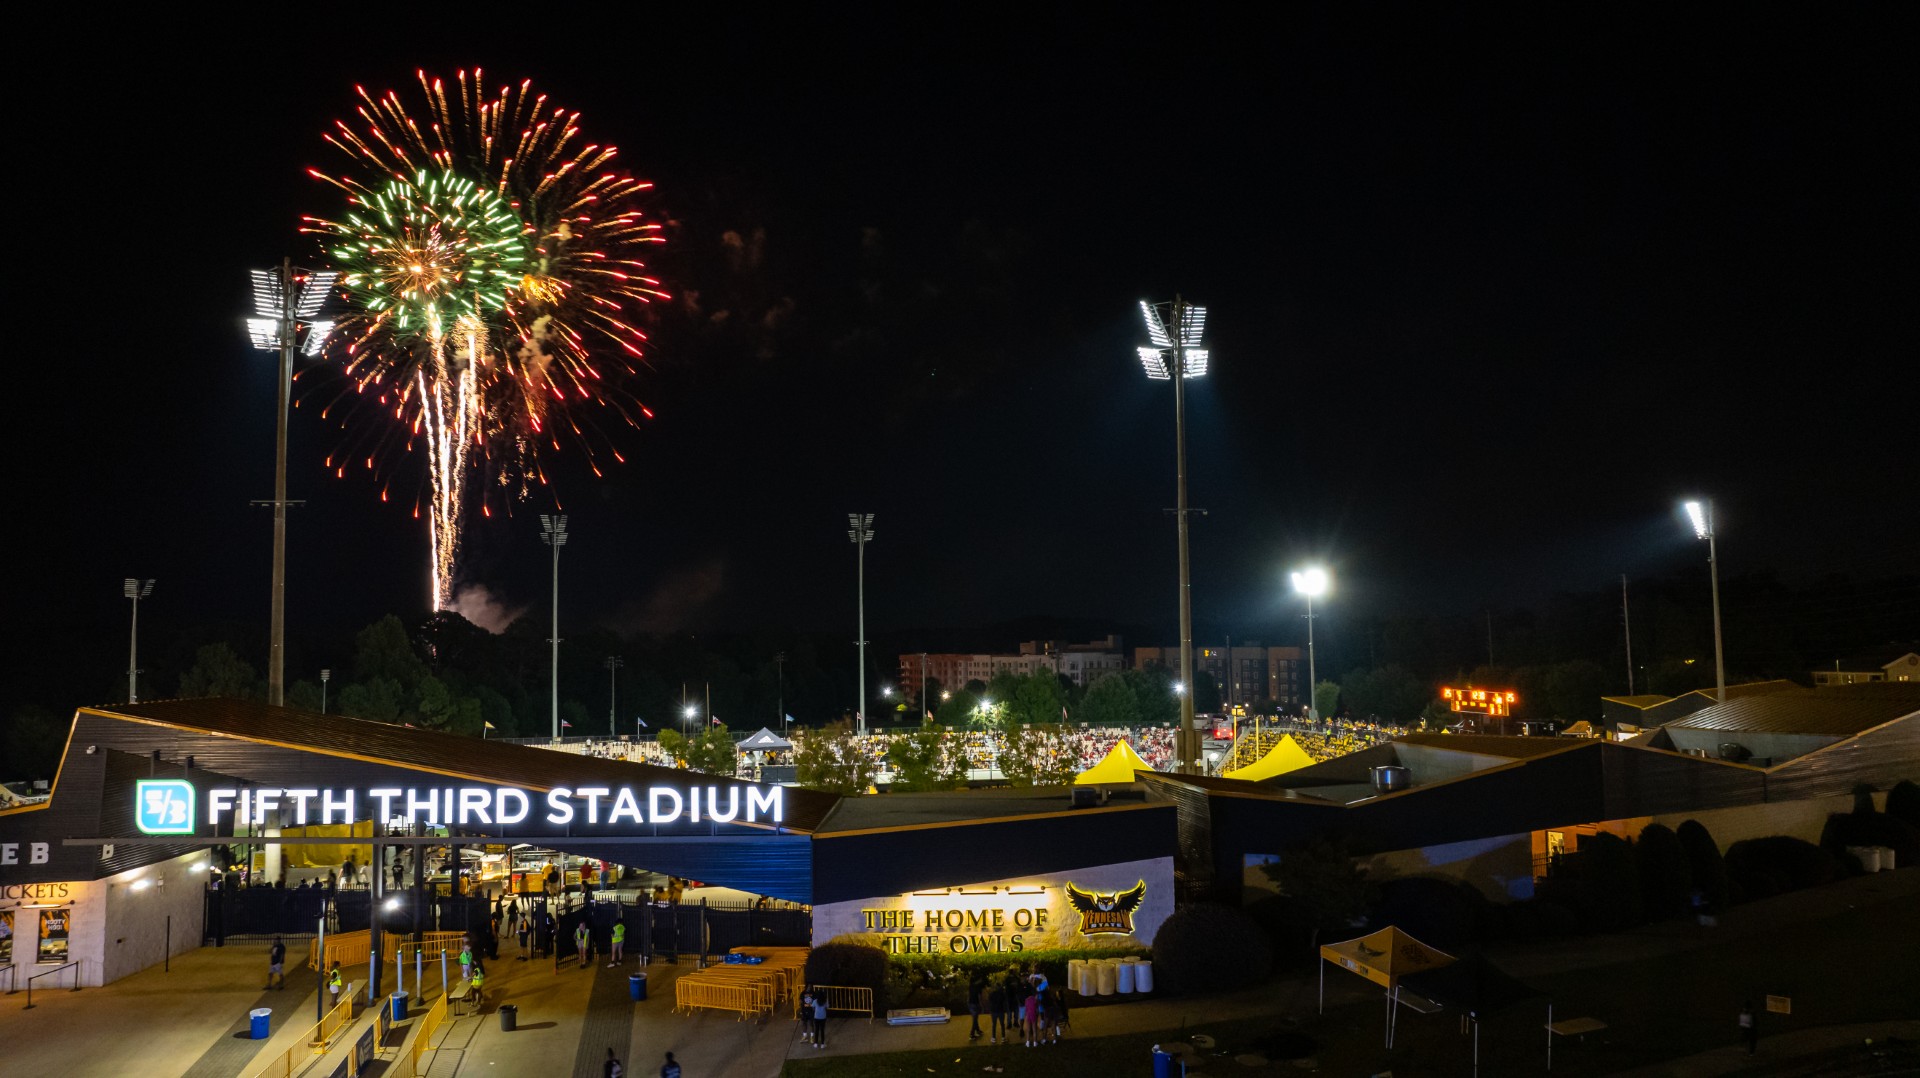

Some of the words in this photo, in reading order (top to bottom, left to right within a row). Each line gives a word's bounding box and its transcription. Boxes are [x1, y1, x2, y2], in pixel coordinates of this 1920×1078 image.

[208, 788, 355, 825] FIFTH
[369, 787, 530, 825] THIRD
[546, 786, 783, 824] STADIUM
[29, 842, 49, 865] B
[862, 909, 915, 929] THE
[924, 908, 1005, 928] HOME
[1014, 907, 1048, 928] OF
[1082, 909, 1131, 930] KENNESAW
[886, 935, 940, 955] THE
[949, 934, 1025, 954] OWLS
